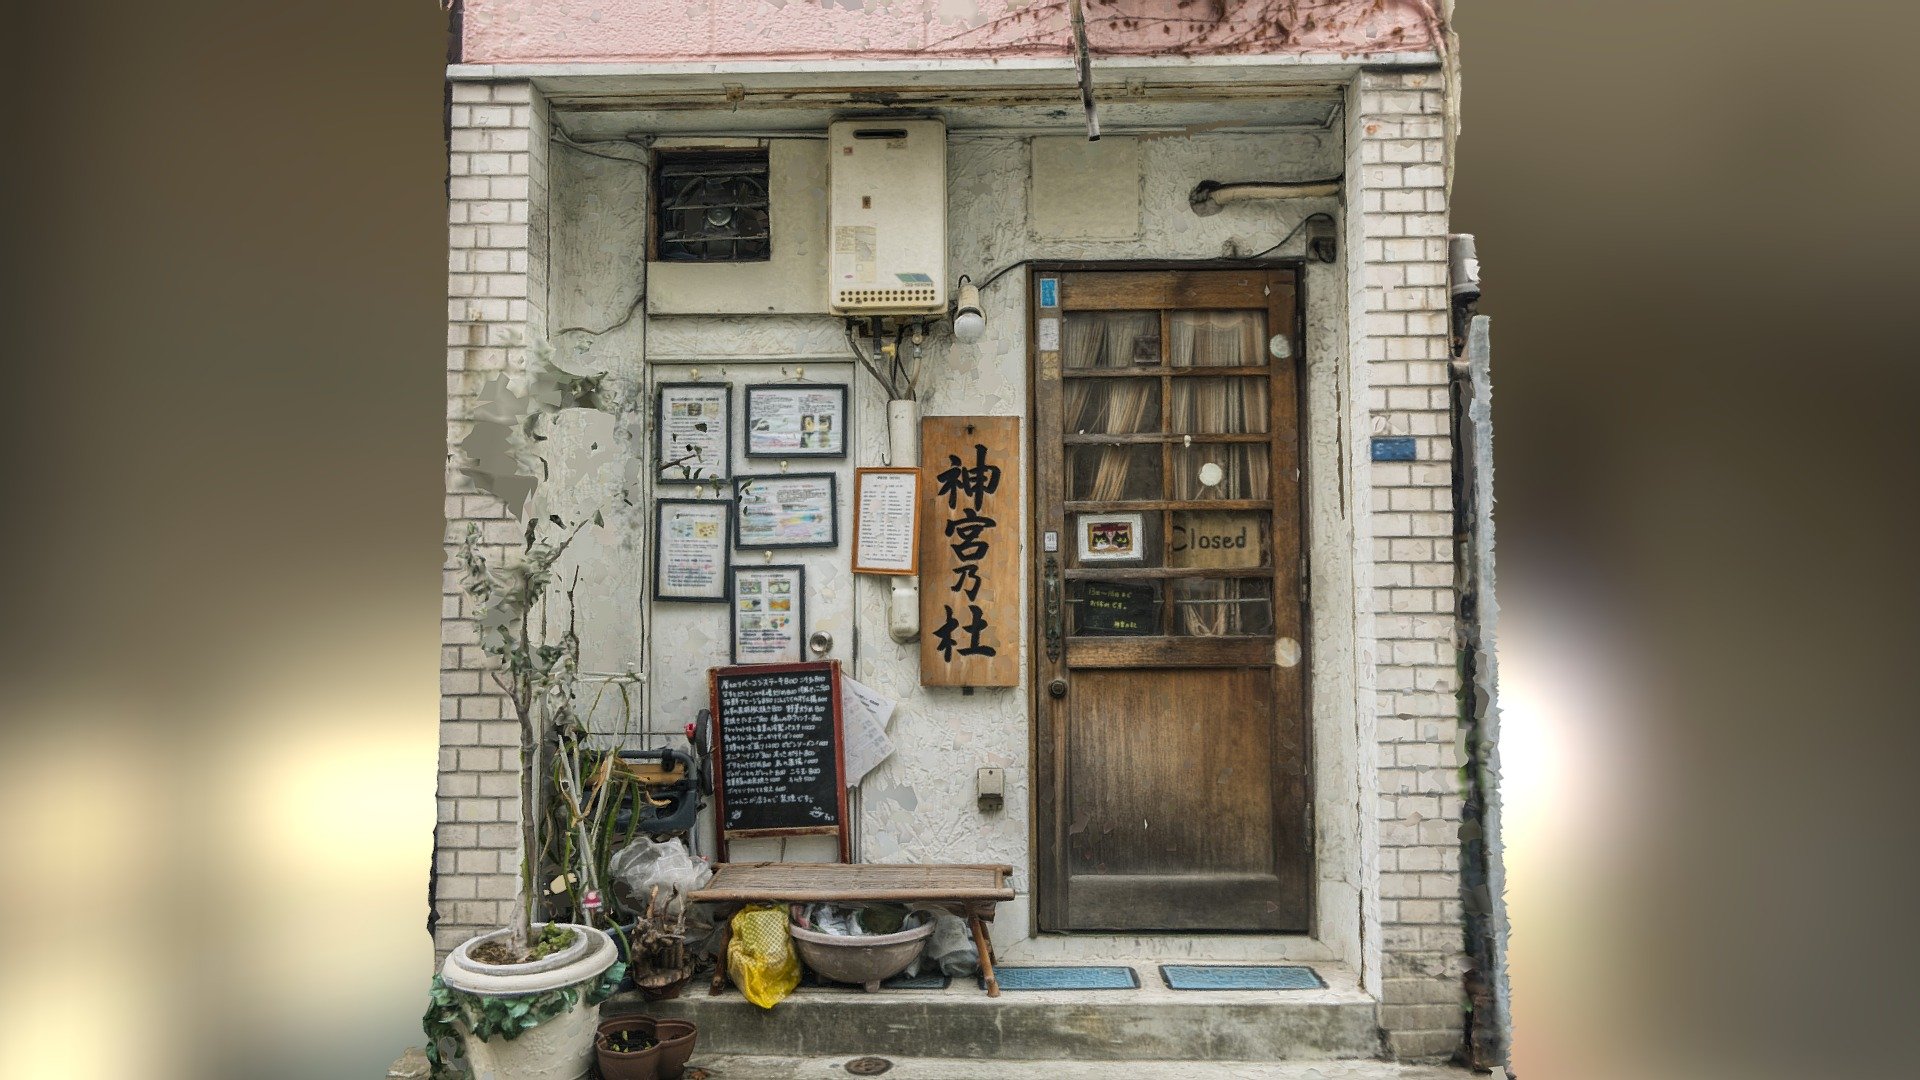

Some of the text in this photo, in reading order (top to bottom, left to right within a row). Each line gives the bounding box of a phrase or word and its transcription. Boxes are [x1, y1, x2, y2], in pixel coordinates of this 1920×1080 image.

[933, 444, 1001, 663] 神宮乃杜
[1173, 525, 1247, 551] Closed
